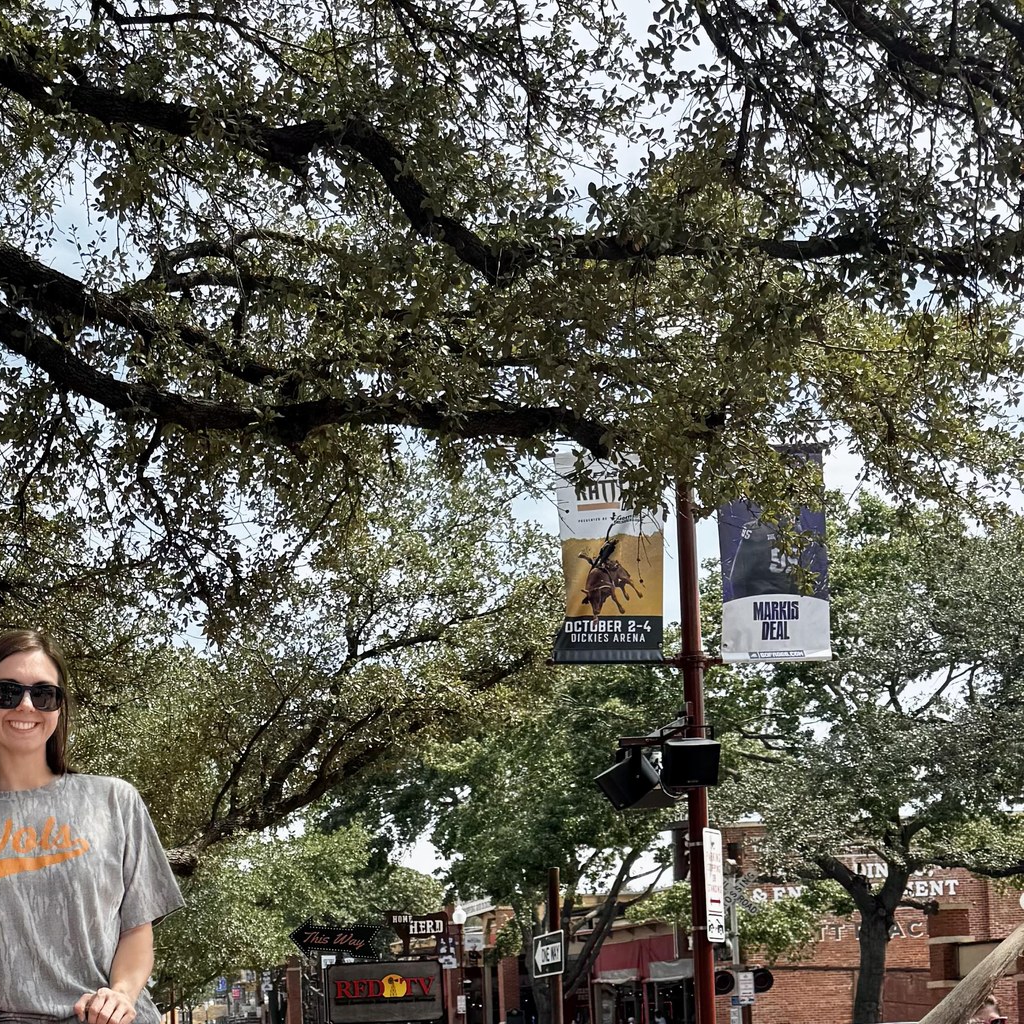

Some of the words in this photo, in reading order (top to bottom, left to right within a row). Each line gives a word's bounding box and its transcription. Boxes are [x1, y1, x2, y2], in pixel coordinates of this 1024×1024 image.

[753, 601, 799, 620] MARKIS
[565, 620, 622, 633] OCTOBER
[628, 620, 652, 633] 2-4
[761, 621, 790, 640] DEAL
[571, 633, 609, 643] DICKIES
[613, 633, 646, 643] ARENA
[738, 895, 757, 913] ROAD
[392, 915, 412, 923] HOME
[409, 920, 444, 934] HERD
[304, 931, 330, 944] This
[333, 933, 366, 950] Way
[335, 978, 384, 999] RFD
[398, 976, 435, 997] TV
